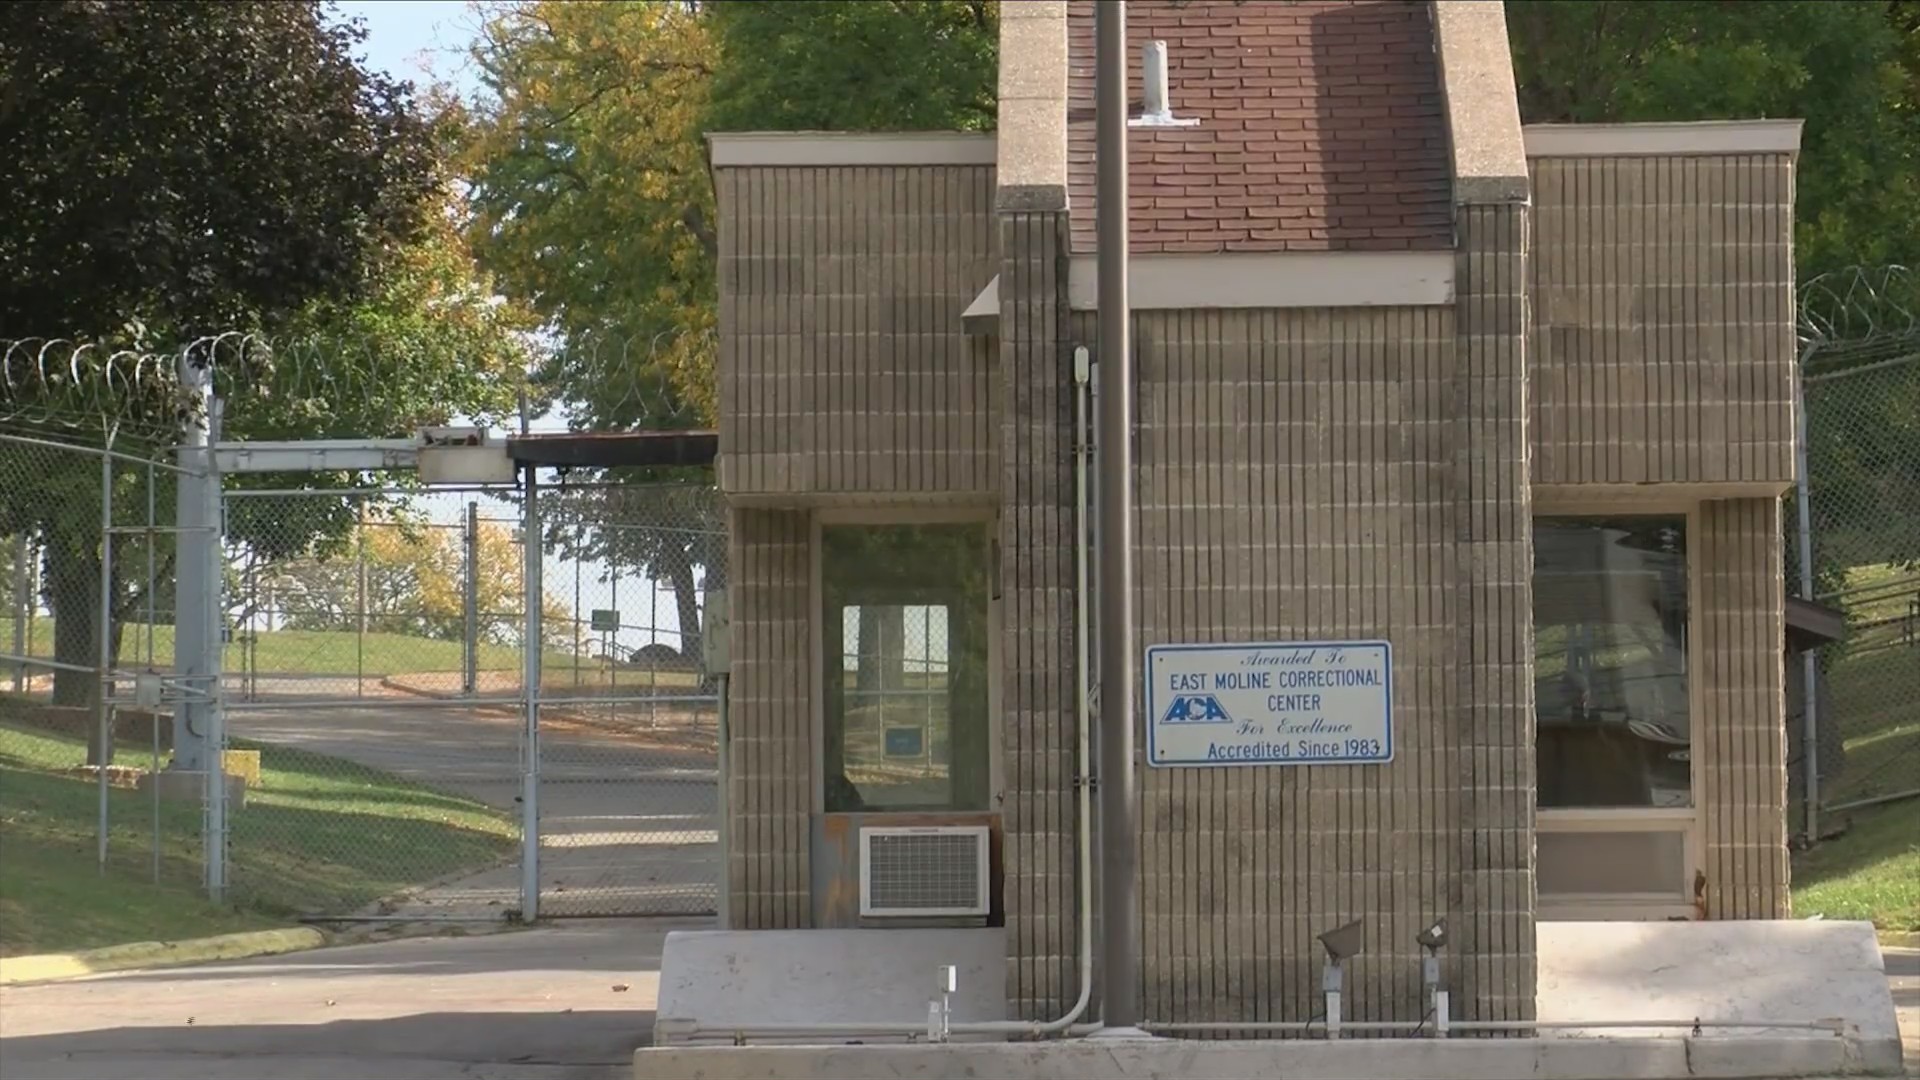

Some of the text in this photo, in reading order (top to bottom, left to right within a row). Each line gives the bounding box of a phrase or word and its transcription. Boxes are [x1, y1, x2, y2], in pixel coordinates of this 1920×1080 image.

[1240, 649, 1347, 666] Awarded To
[1170, 669, 1382, 690] EAST MOLINE CORRECTIONAL
[1164, 696, 1228, 721] ACA
[1267, 694, 1321, 712] CENTER
[1236, 717, 1352, 735] For Excellence
[1207, 739, 1380, 759] Accredited Since 1983
